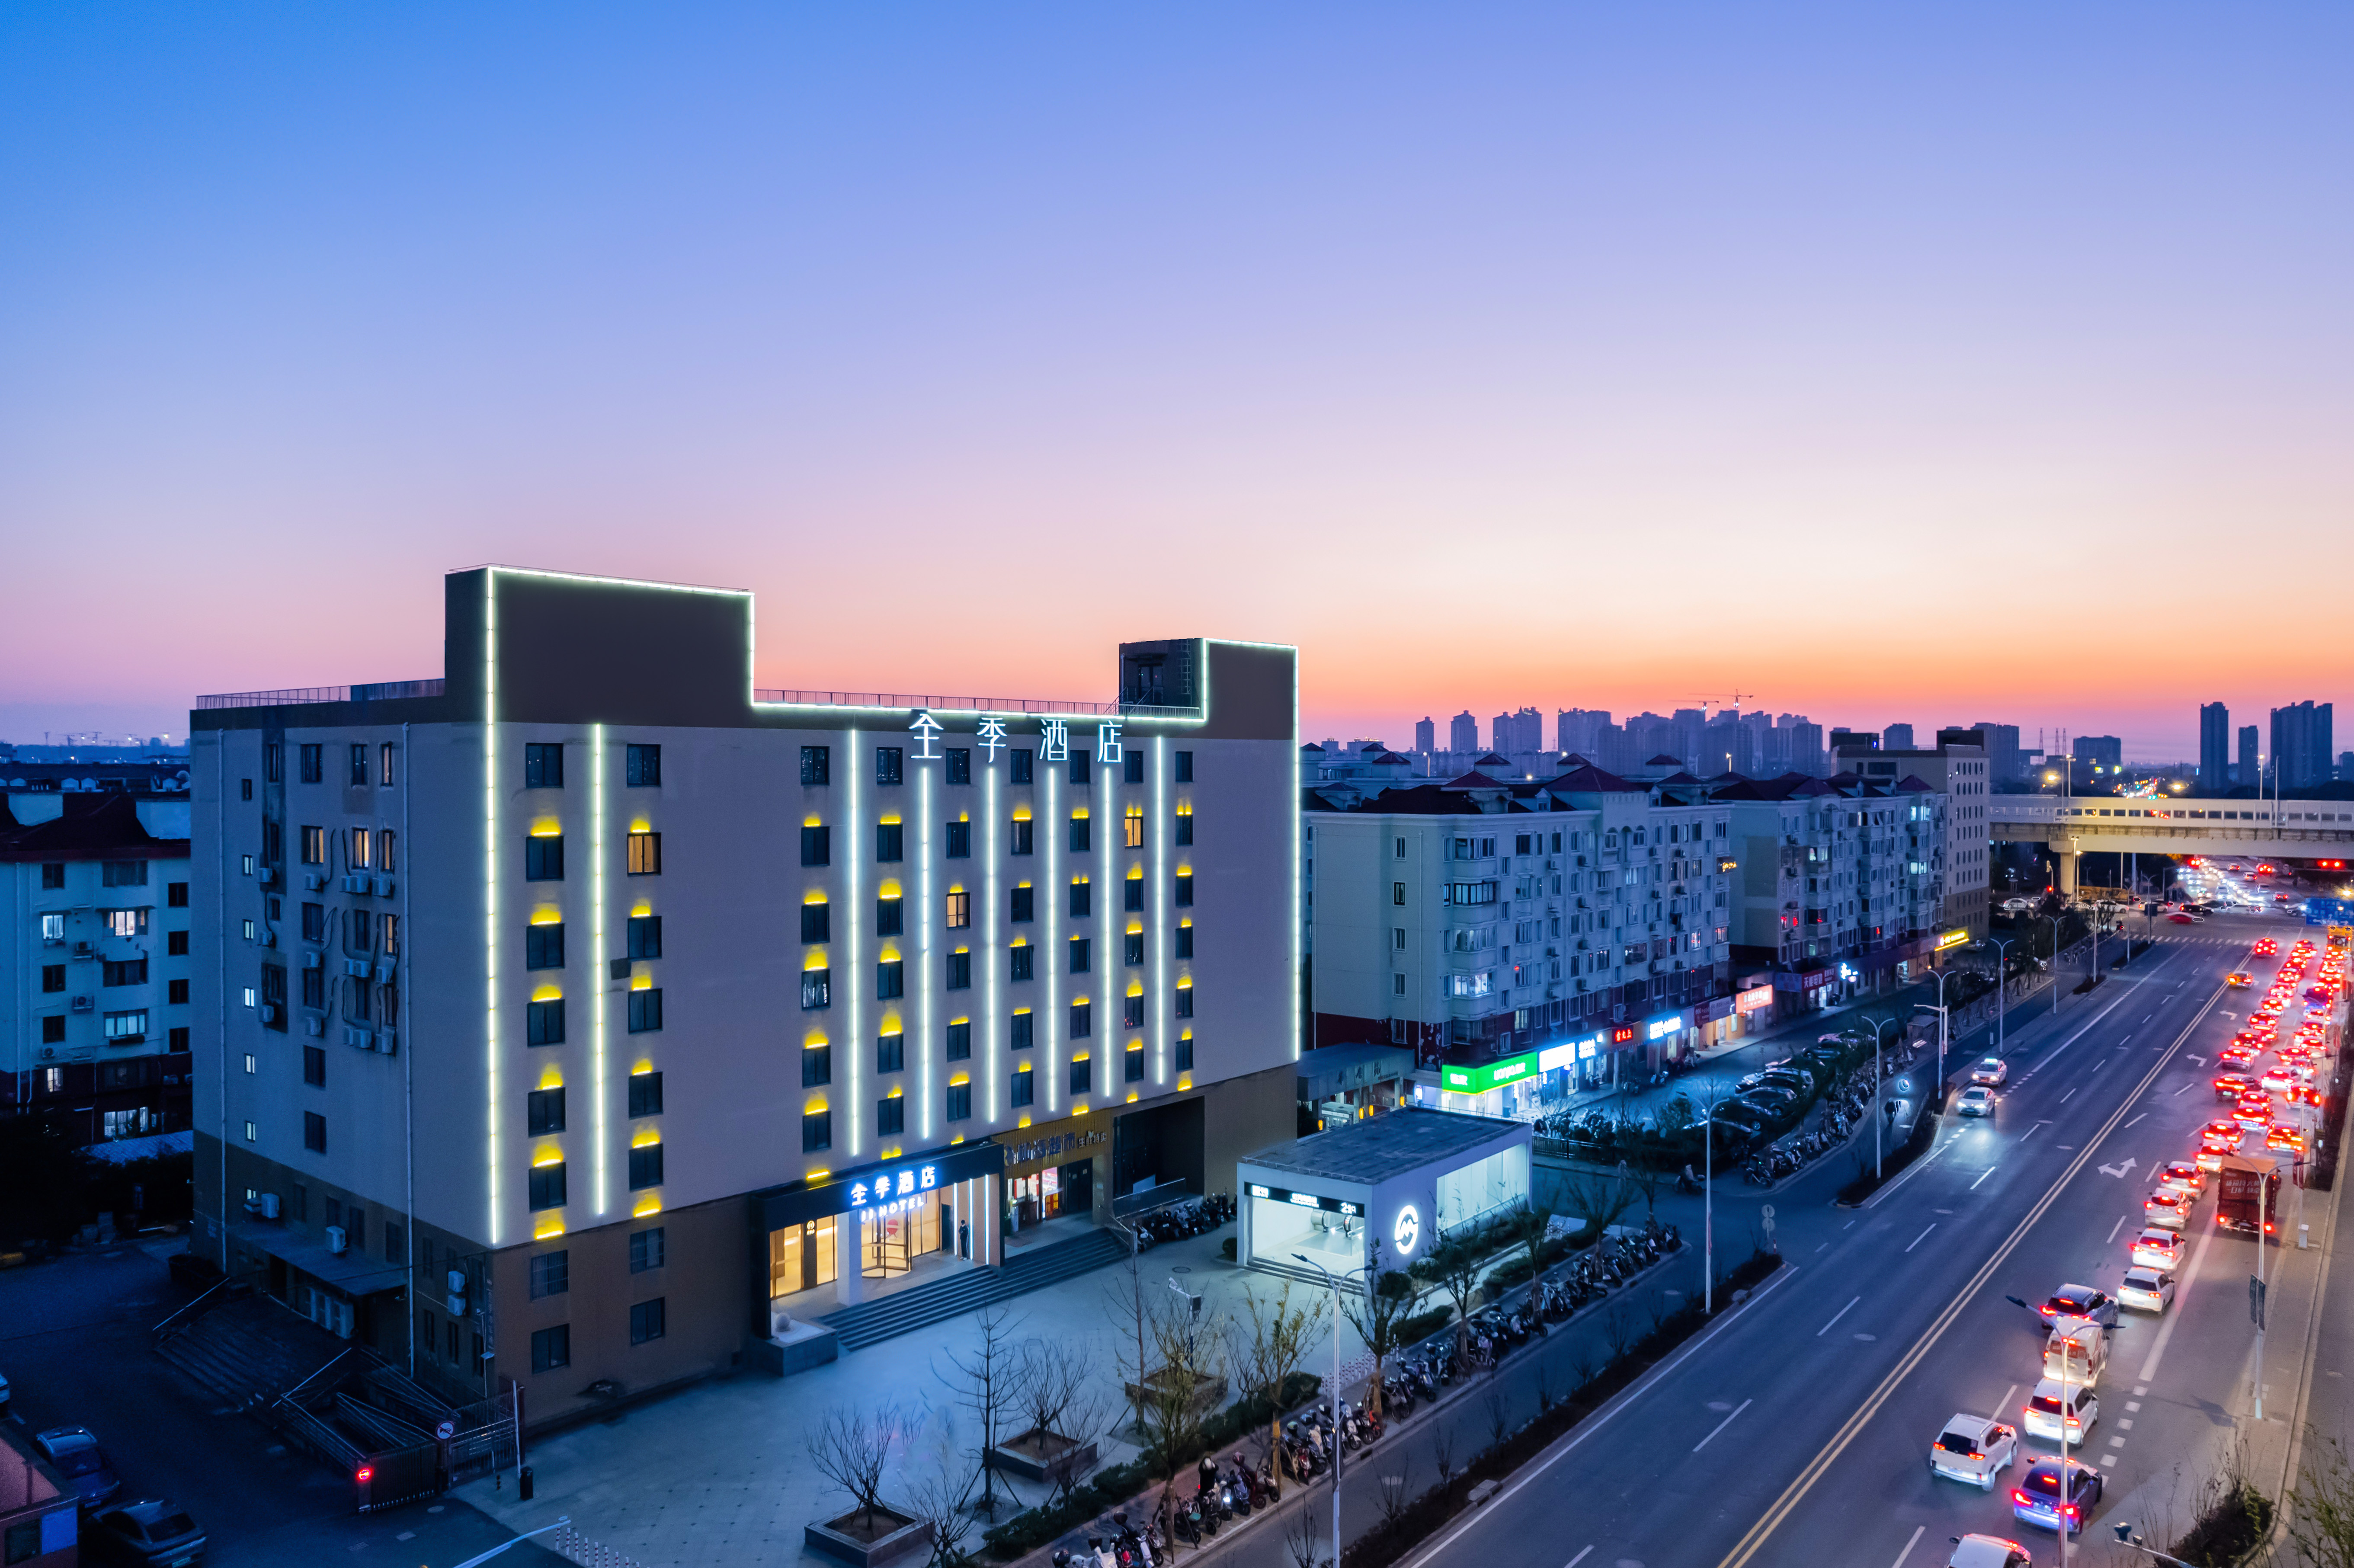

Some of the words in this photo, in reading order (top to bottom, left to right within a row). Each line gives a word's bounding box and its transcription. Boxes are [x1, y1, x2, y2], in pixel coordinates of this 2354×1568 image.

[909, 713, 1122, 763] 全季酒店
[851, 1166, 935, 1206] 全季酒店
[879, 1196, 924, 1218] HOTEL
